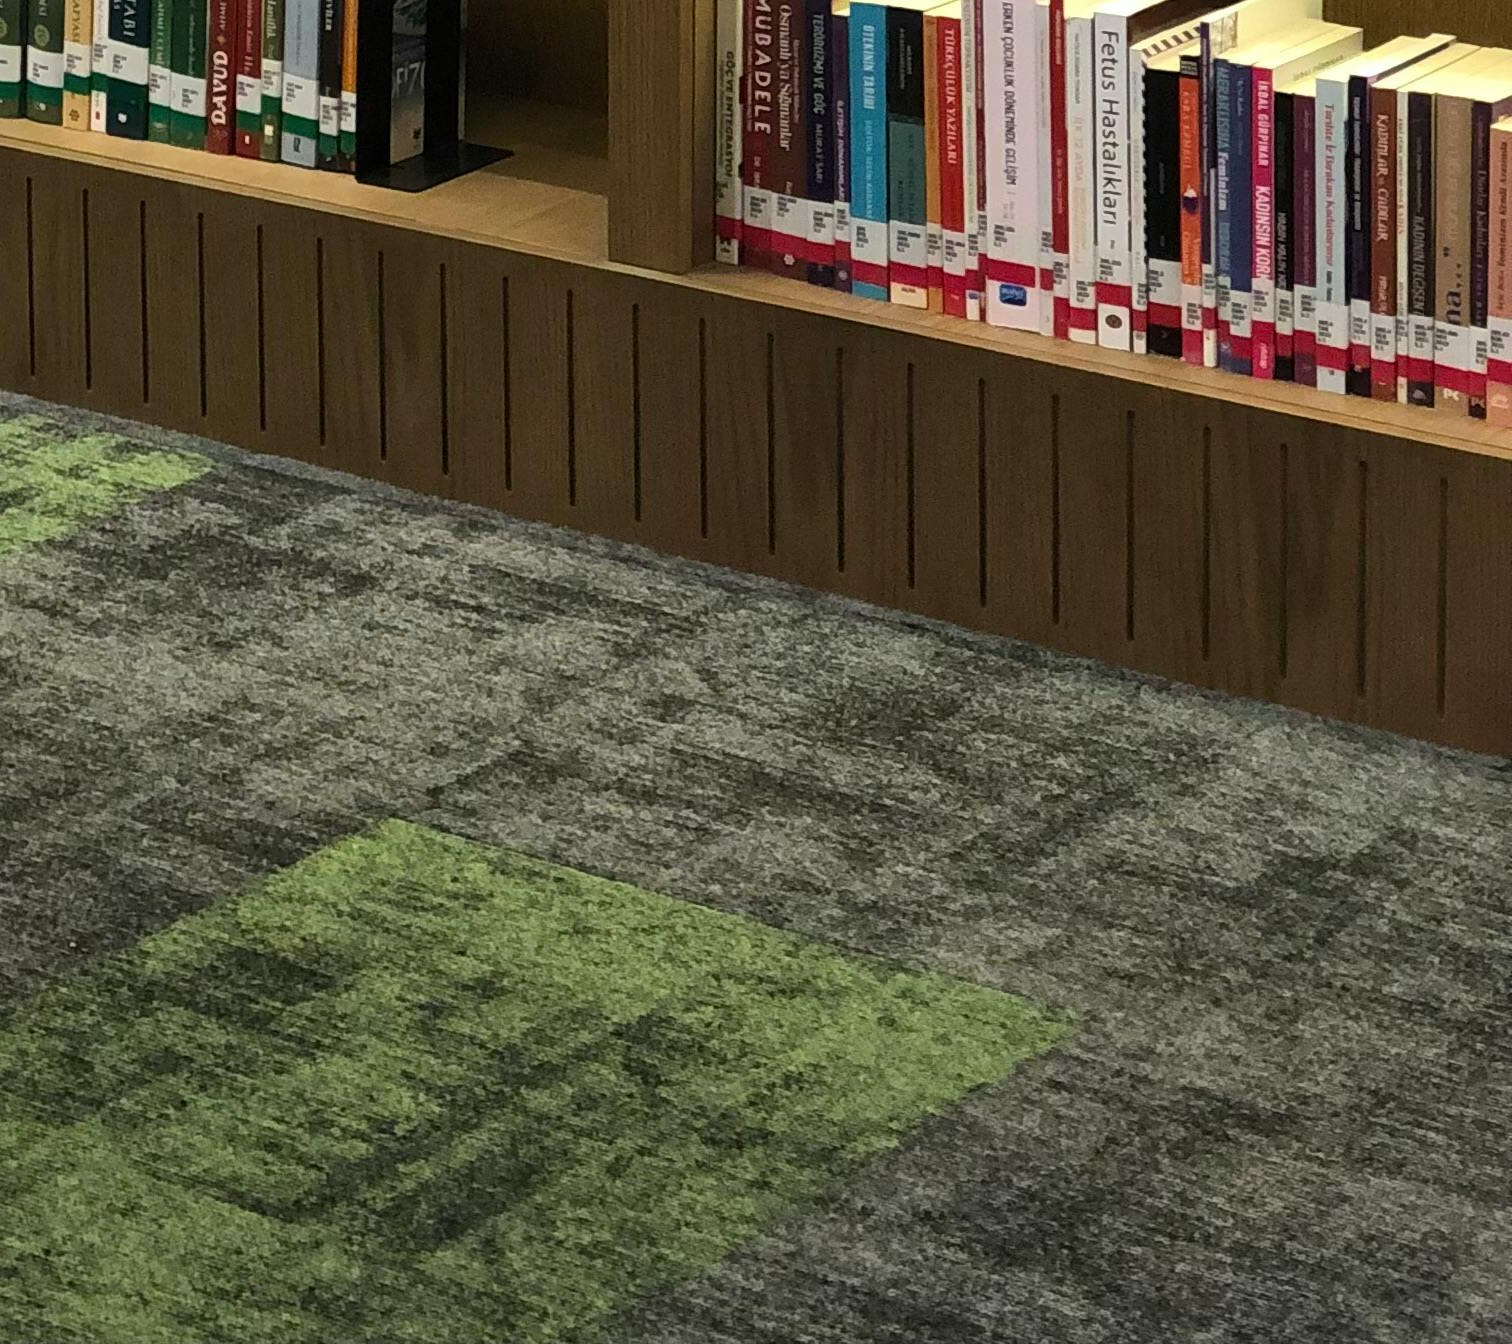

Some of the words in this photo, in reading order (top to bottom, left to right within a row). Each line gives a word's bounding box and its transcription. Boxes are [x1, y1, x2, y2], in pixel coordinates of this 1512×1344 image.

[210, 49, 229, 125] DAVUD
[1001, 36, 1015, 87] ÇOCUKLUK
[1101, 30, 1120, 91] Fetus
[946, 107, 957, 164] YAZILARI
[1102, 98, 1123, 226] Hastalıkları
[1257, 113, 1271, 167] GÜRPINAR
[1255, 185, 1271, 246] KADINSIN
